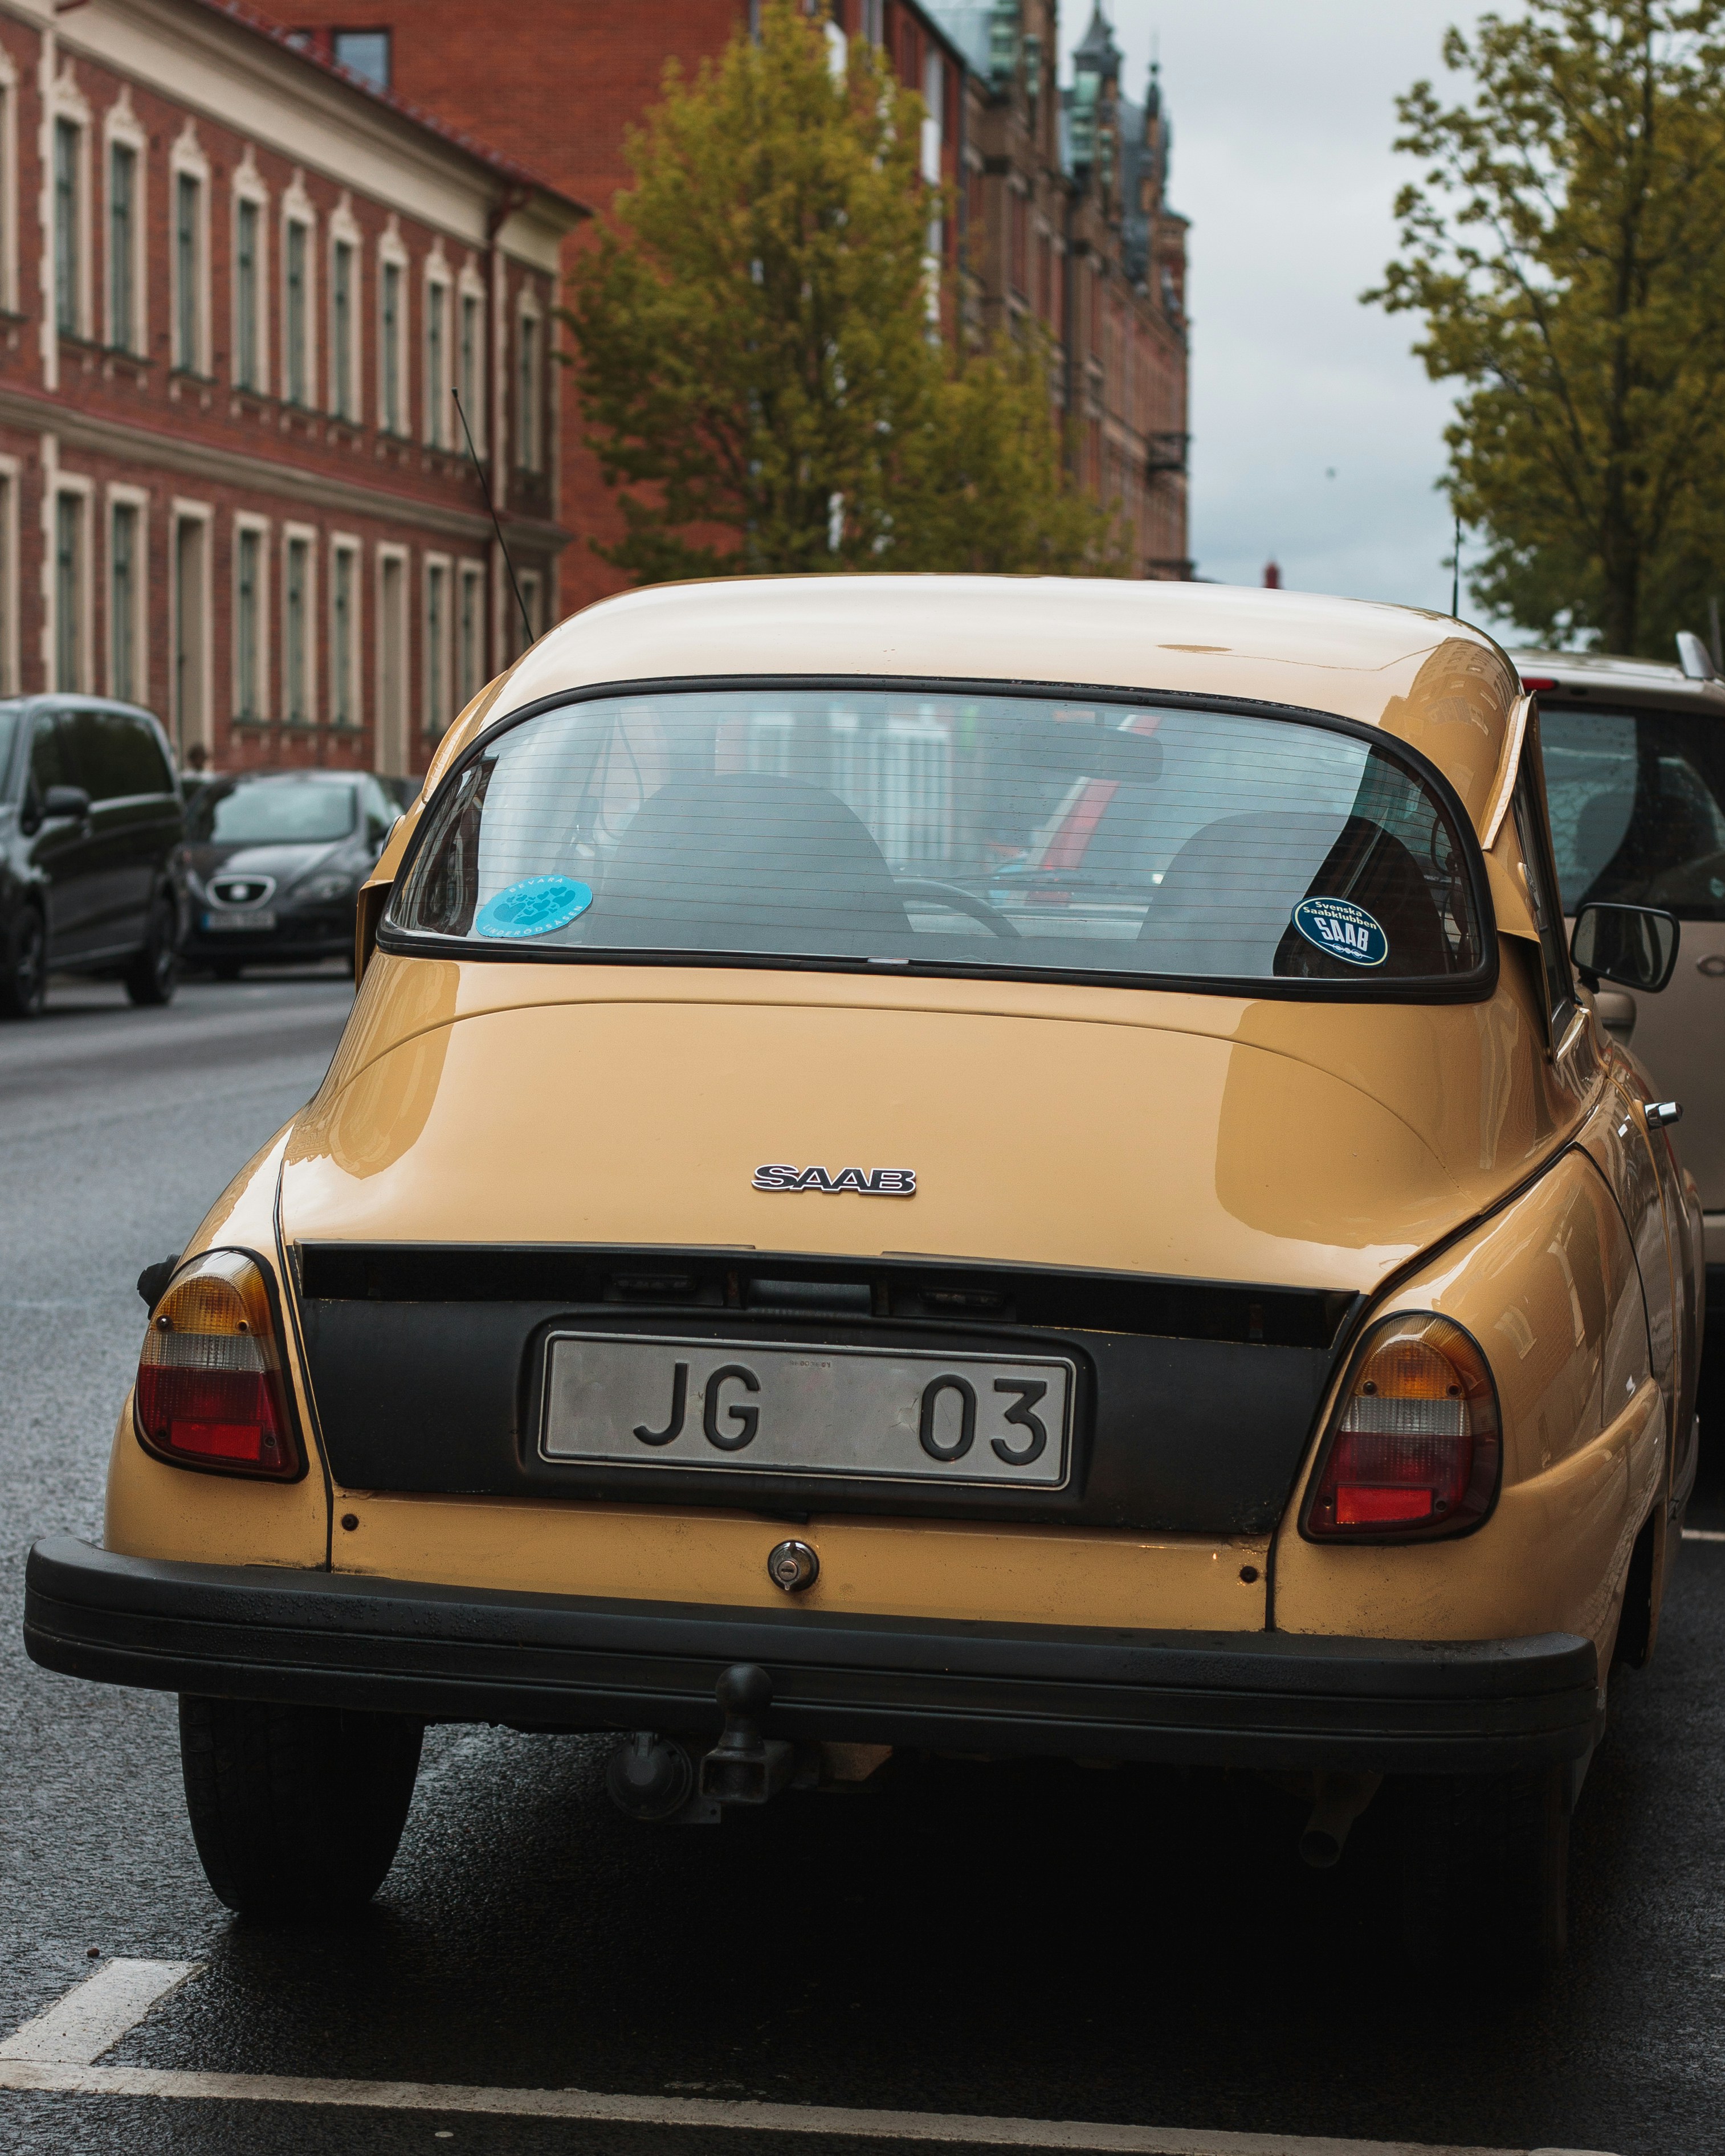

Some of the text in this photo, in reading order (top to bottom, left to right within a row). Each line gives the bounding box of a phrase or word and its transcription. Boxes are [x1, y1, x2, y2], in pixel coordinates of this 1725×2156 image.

[509, 877, 563, 893] BEVARA
[1303, 906, 1377, 930] Saabklubben
[1315, 901, 1363, 917] Svenska
[1314, 917, 1369, 952] SAAB
[751, 1163, 916, 1195] SAAB
[633, 1362, 1047, 1466] JG 03
